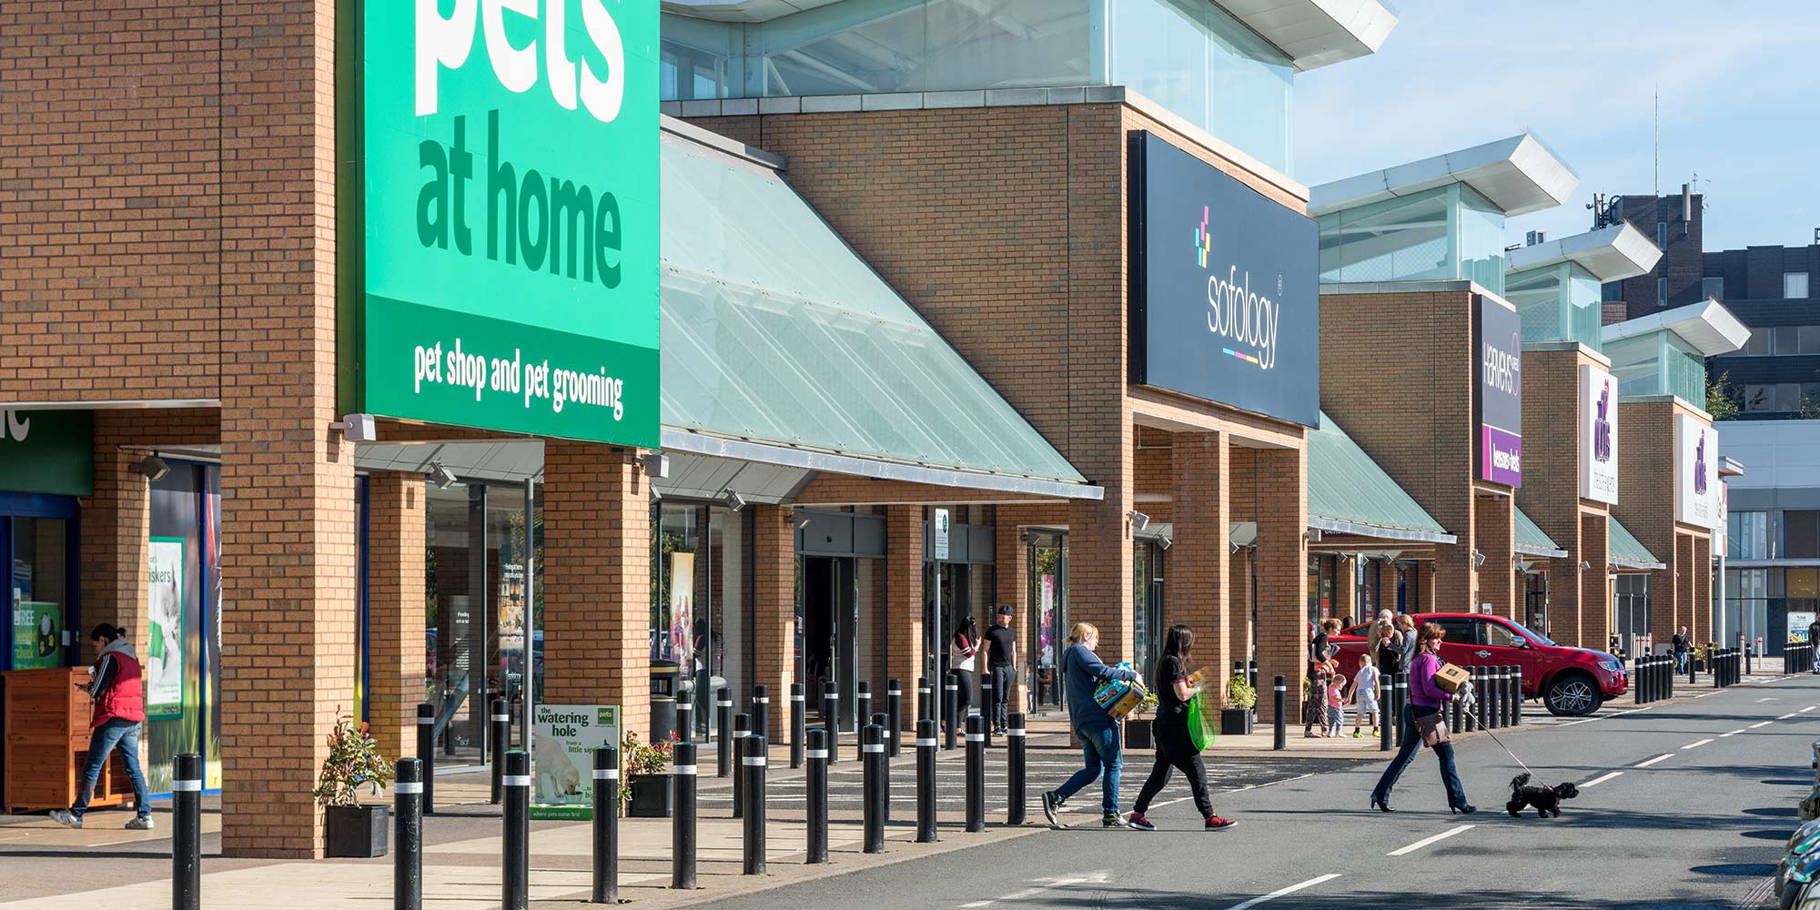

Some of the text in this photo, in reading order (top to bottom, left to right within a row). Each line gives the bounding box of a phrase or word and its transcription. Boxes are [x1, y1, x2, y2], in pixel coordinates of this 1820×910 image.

[415, 0, 625, 123] pets
[416, 108, 622, 290] at home
[1207, 264, 1279, 370] sofology
[414, 337, 624, 421] pet shop and pet grooming
[537, 712, 589, 727] watering
[552, 724, 577, 737] hole
